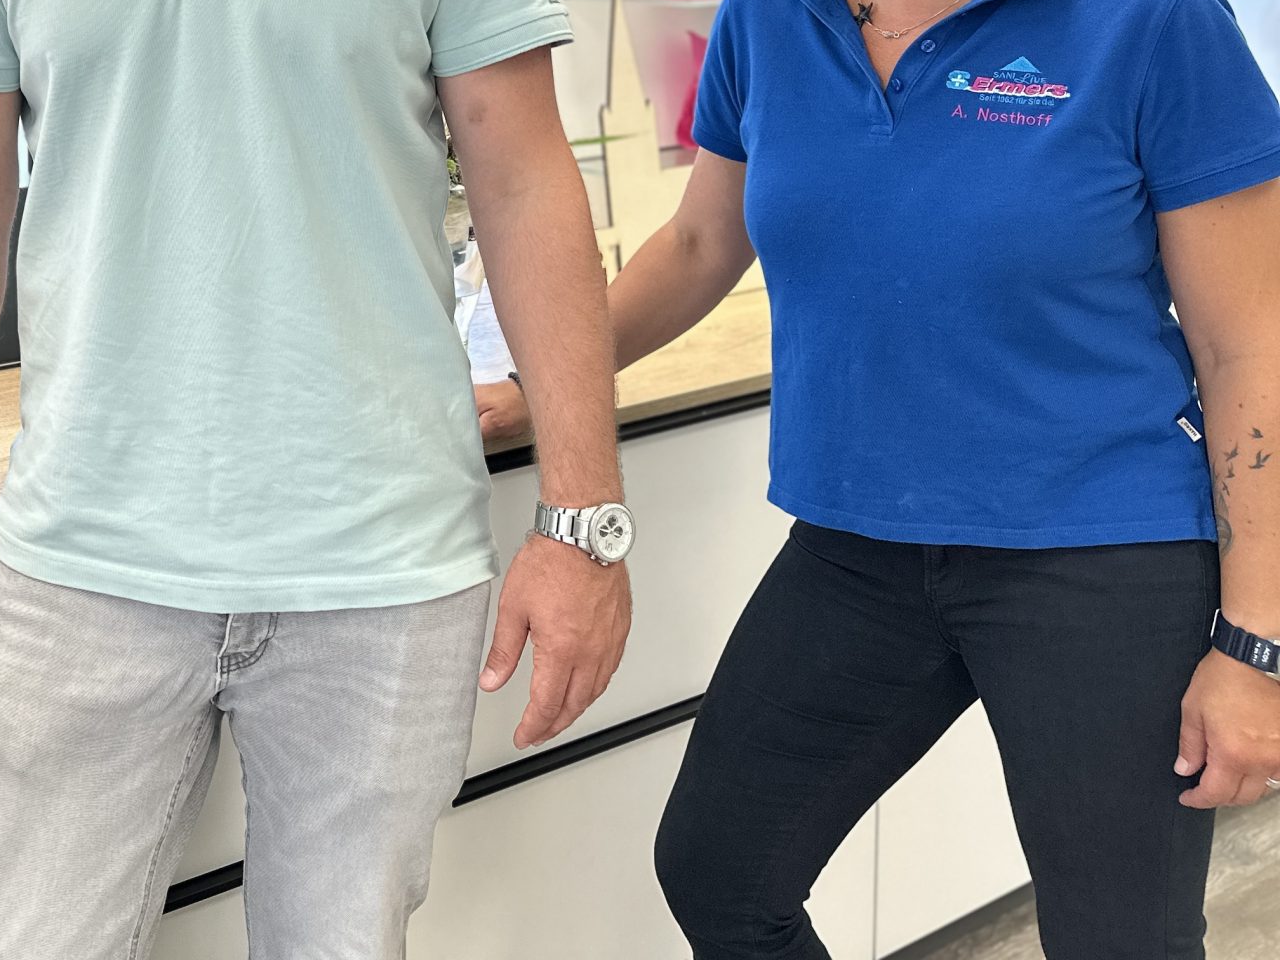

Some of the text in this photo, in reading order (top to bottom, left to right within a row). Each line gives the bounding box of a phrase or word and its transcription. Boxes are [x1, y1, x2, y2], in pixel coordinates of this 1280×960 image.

[972, 76, 1068, 97] Ermers
[979, 94, 996, 102] Seit
[951, 104, 1053, 127] A. Nosthoff
